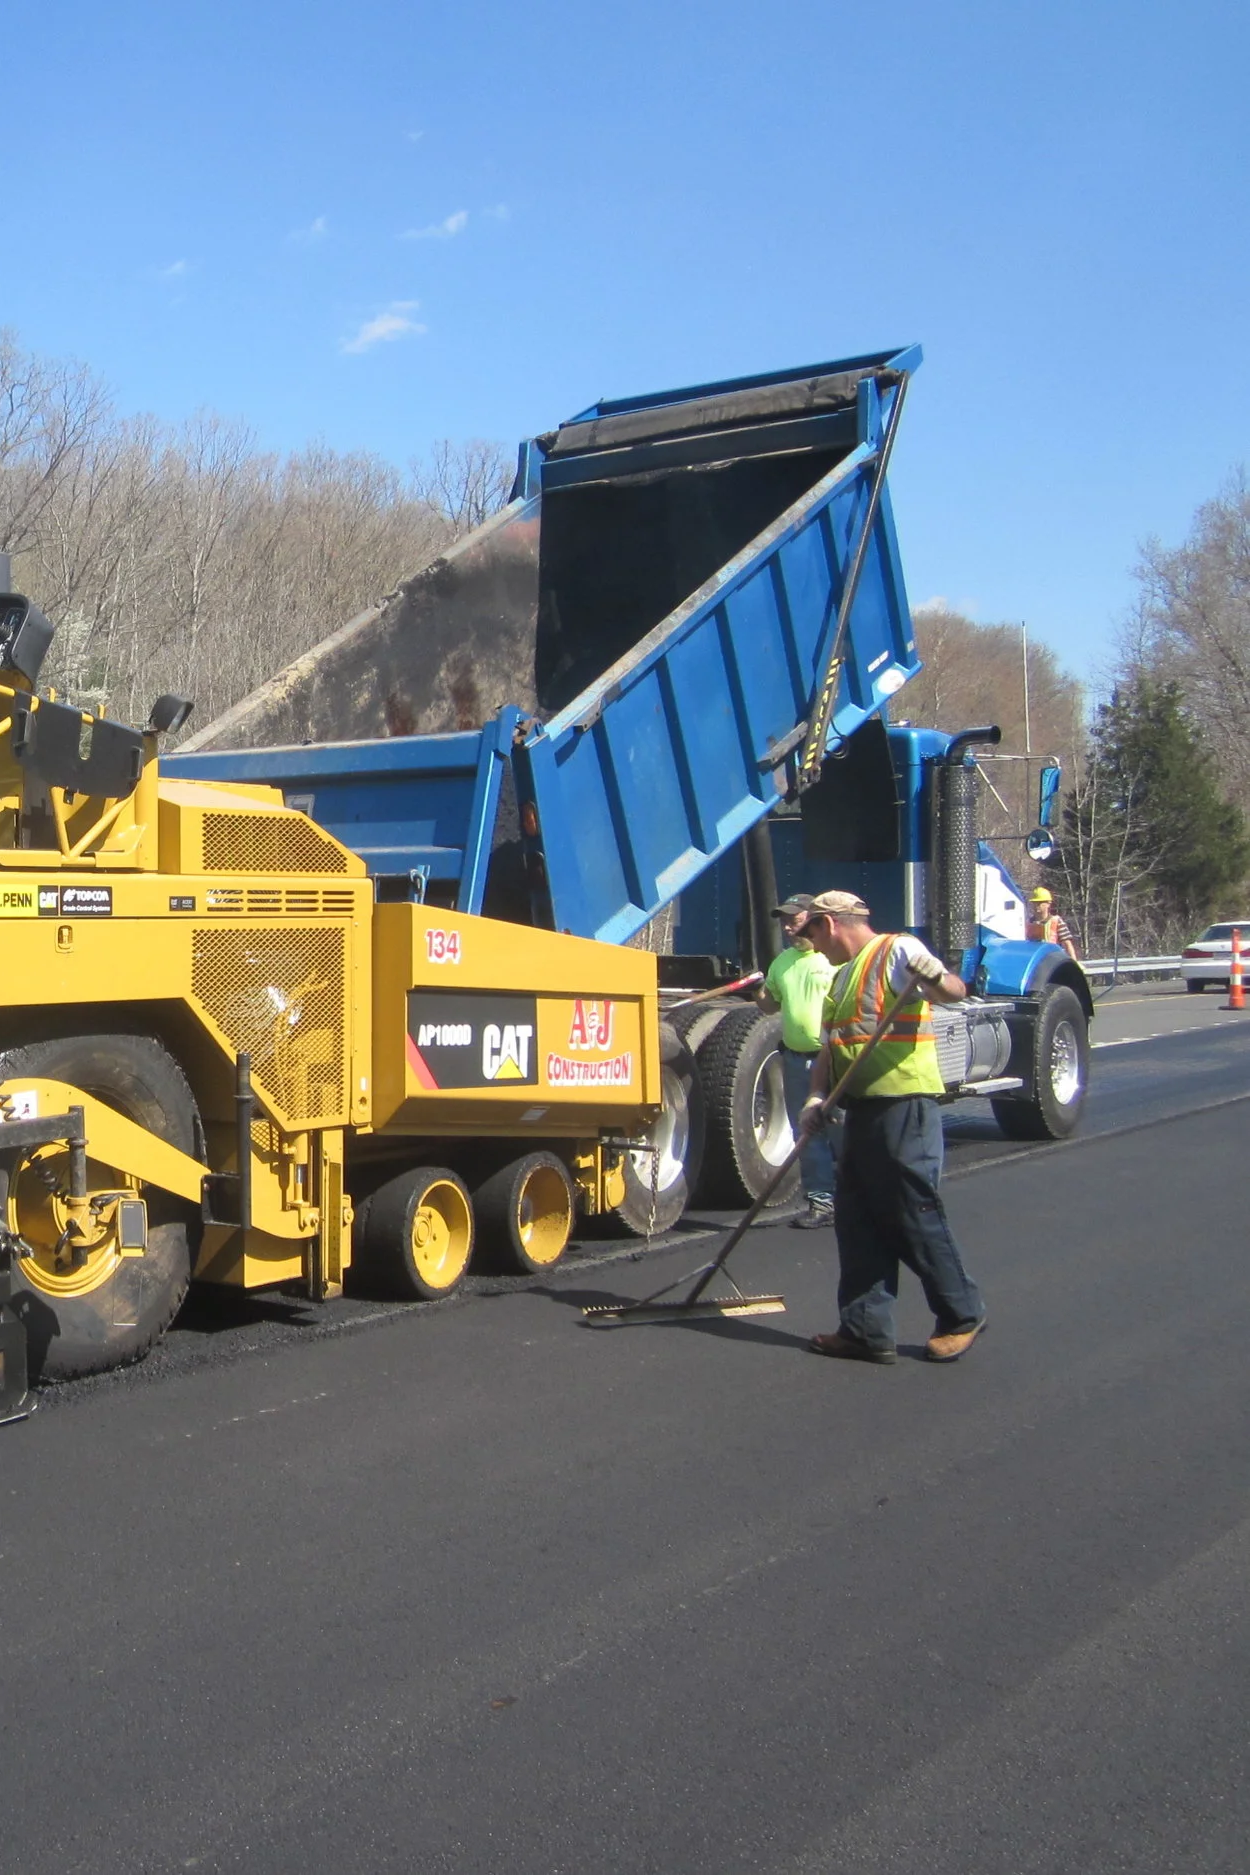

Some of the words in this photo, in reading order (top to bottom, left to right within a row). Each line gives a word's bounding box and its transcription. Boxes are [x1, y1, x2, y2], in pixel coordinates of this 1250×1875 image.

[39, 892, 58, 908] CAT
[425, 929, 461, 963] 134
[568, 999, 614, 1050] A&J
[482, 1024, 533, 1080] CAT
[547, 1052, 631, 1085] CONSTRUCTION
